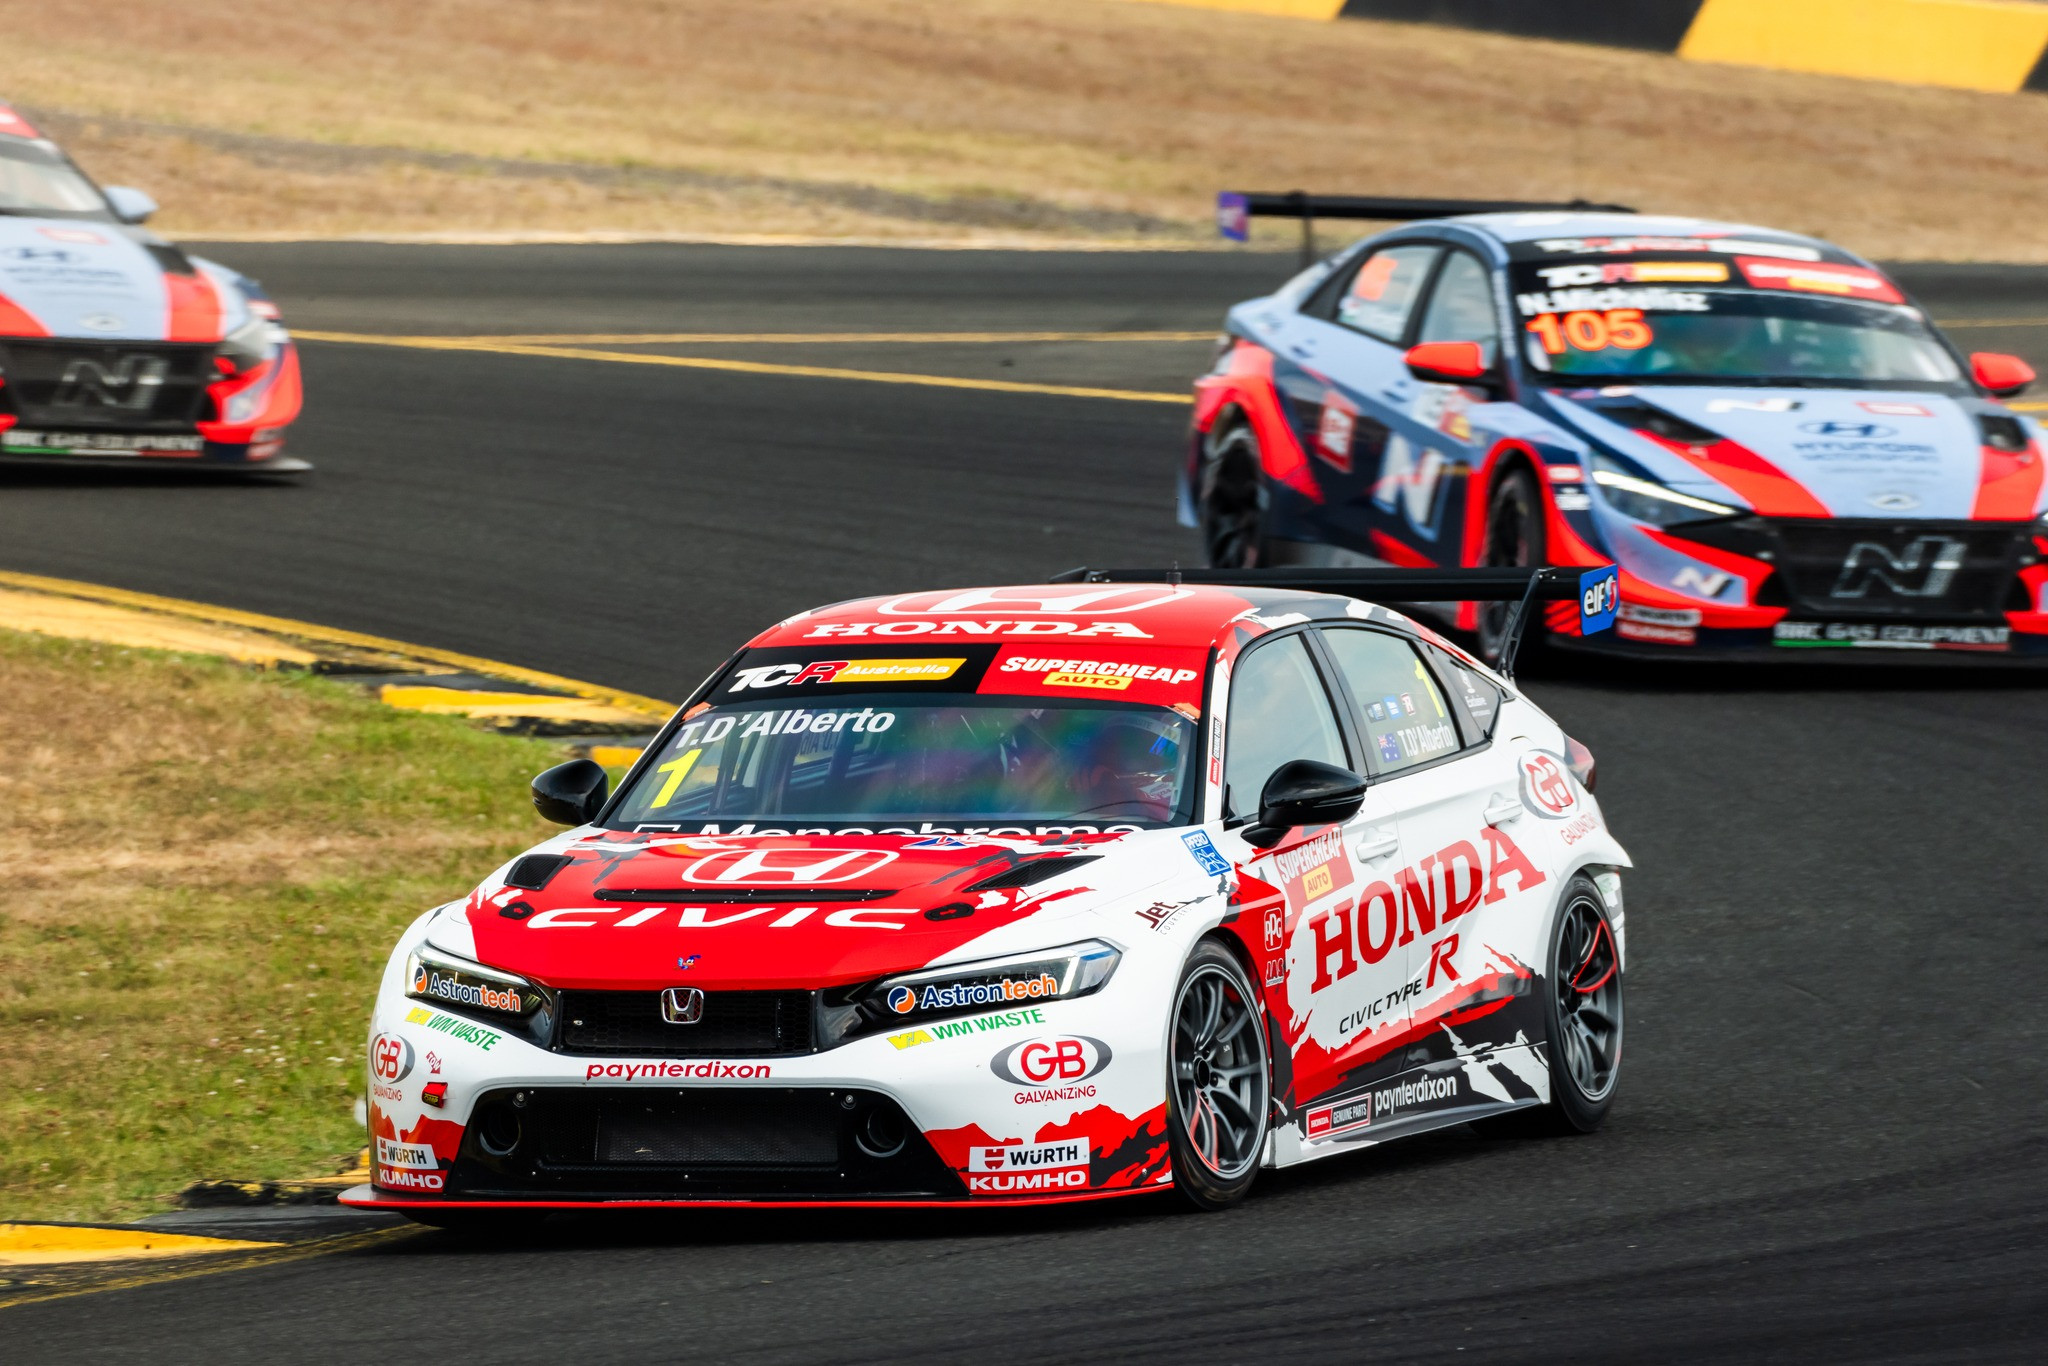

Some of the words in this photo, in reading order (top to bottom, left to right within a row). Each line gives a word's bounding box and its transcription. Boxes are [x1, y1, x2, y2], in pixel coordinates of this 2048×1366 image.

[1526, 308, 1654, 355] 105
[1583, 582, 1606, 616] elf
[803, 621, 1155, 639] HONDA
[728, 660, 852, 693] TCR
[843, 664, 950, 676] Australia
[1000, 656, 1198, 685] SUPERCHEAP
[1054, 675, 1121, 686] AUTO
[1414, 659, 1445, 718] 1
[649, 748, 703, 809] 1
[1185, 832, 1210, 851] PFERD
[1279, 826, 1344, 885] SUPERCHEAP
[1307, 871, 1329, 895] AUTO
[526, 907, 922, 930] CIVIC
[1134, 901, 1179, 930] Jet
[1308, 826, 1547, 995] HONDA
[1264, 913, 1283, 947] PPG
[429, 972, 522, 1013] Astrontech
[920, 973, 1059, 1010] Astrontech
[1339, 998, 1383, 1035] CIVIC
[1386, 977, 1423, 1013] TYPE
[1425, 933, 1462, 990] R
[427, 1014, 456, 1034] WM
[451, 1022, 503, 1052] WASTE
[931, 1019, 975, 1041] WM
[972, 1008, 1047, 1033] WASTE
[375, 1037, 402, 1079] GB
[426, 1053, 442, 1072] TOW
[585, 1061, 772, 1082] paynterdixon
[1020, 1039, 1087, 1083] GB
[1374, 1074, 1458, 1118] paynterdixon
[1310, 1115, 1330, 1128] HONDA
[1332, 1108, 1353, 1125] GENUINE
[1353, 1102, 1368, 1119] PARTS
[387, 1145, 428, 1165] WÜRTH
[1009, 1145, 1079, 1167] WÜRTH
[379, 1168, 443, 1189] KUMHO
[969, 1170, 1087, 1191] KUMHO
